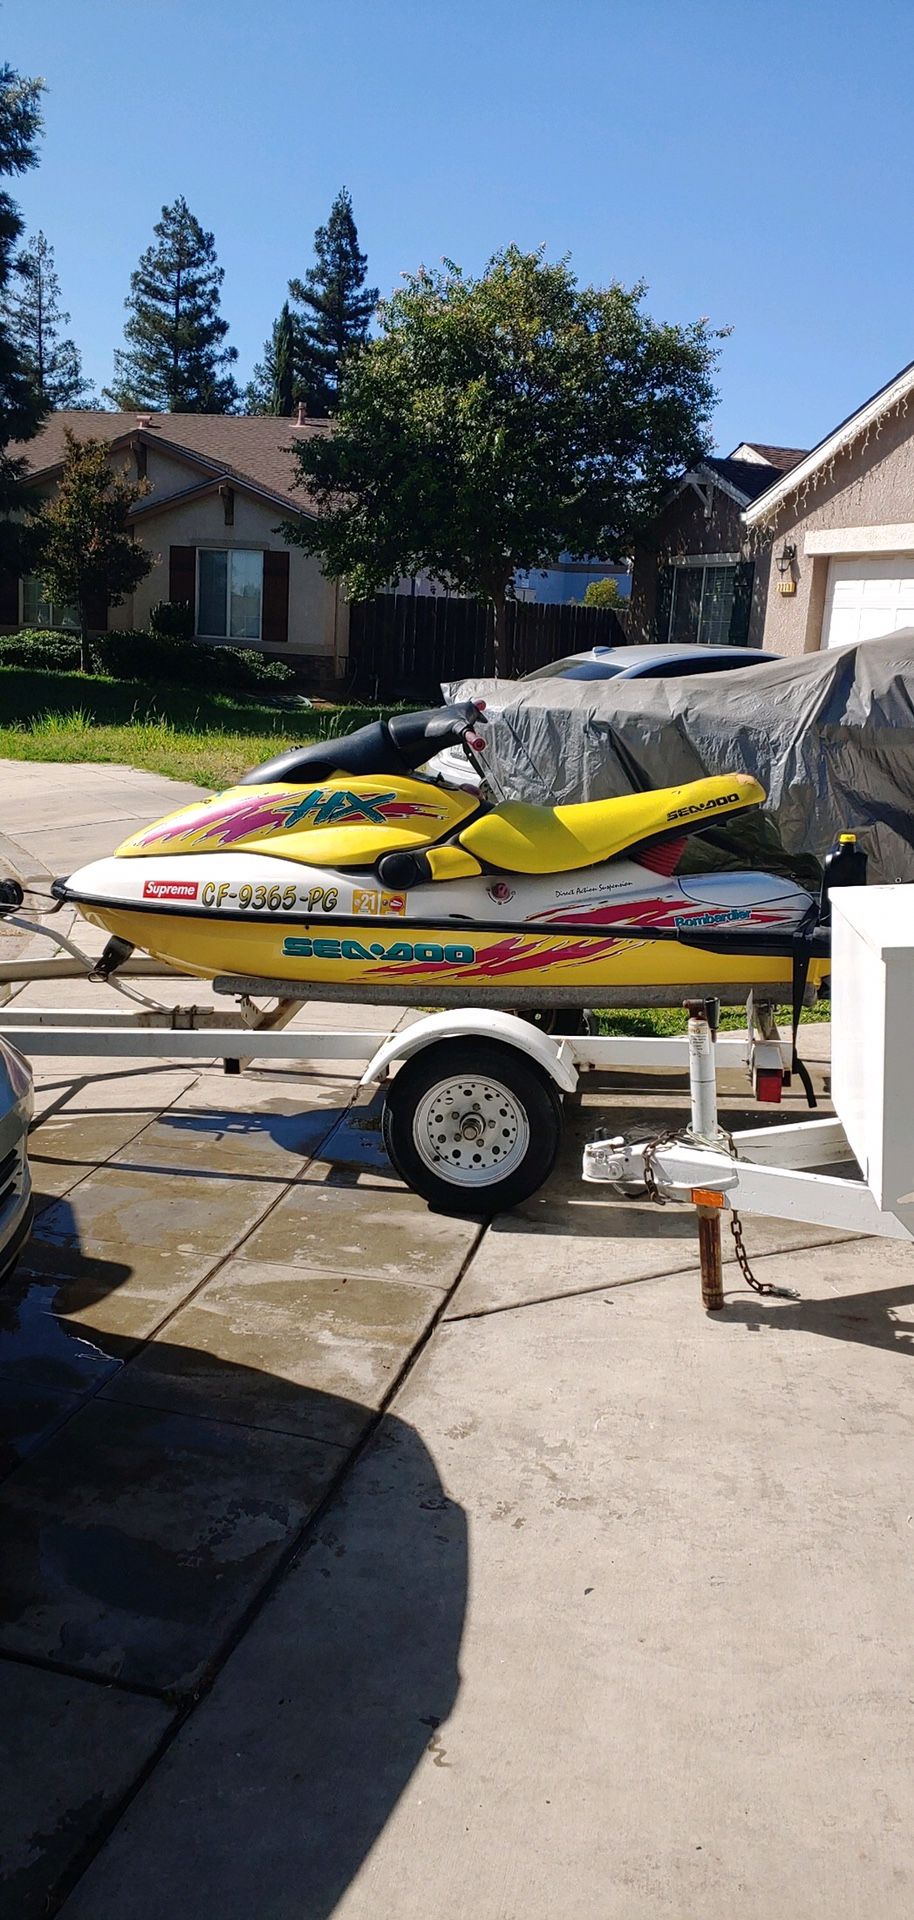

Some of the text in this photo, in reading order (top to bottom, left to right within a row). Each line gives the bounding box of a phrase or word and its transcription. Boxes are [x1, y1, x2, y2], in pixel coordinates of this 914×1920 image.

[272, 789, 397, 829] HX
[145, 881, 196, 897] Supreme
[201, 881, 339, 913] CF-9365-PG
[555, 881, 633, 898] Direct Action Suspension
[360, 893, 376, 910] 21
[674, 908, 752, 927] Bombardier
